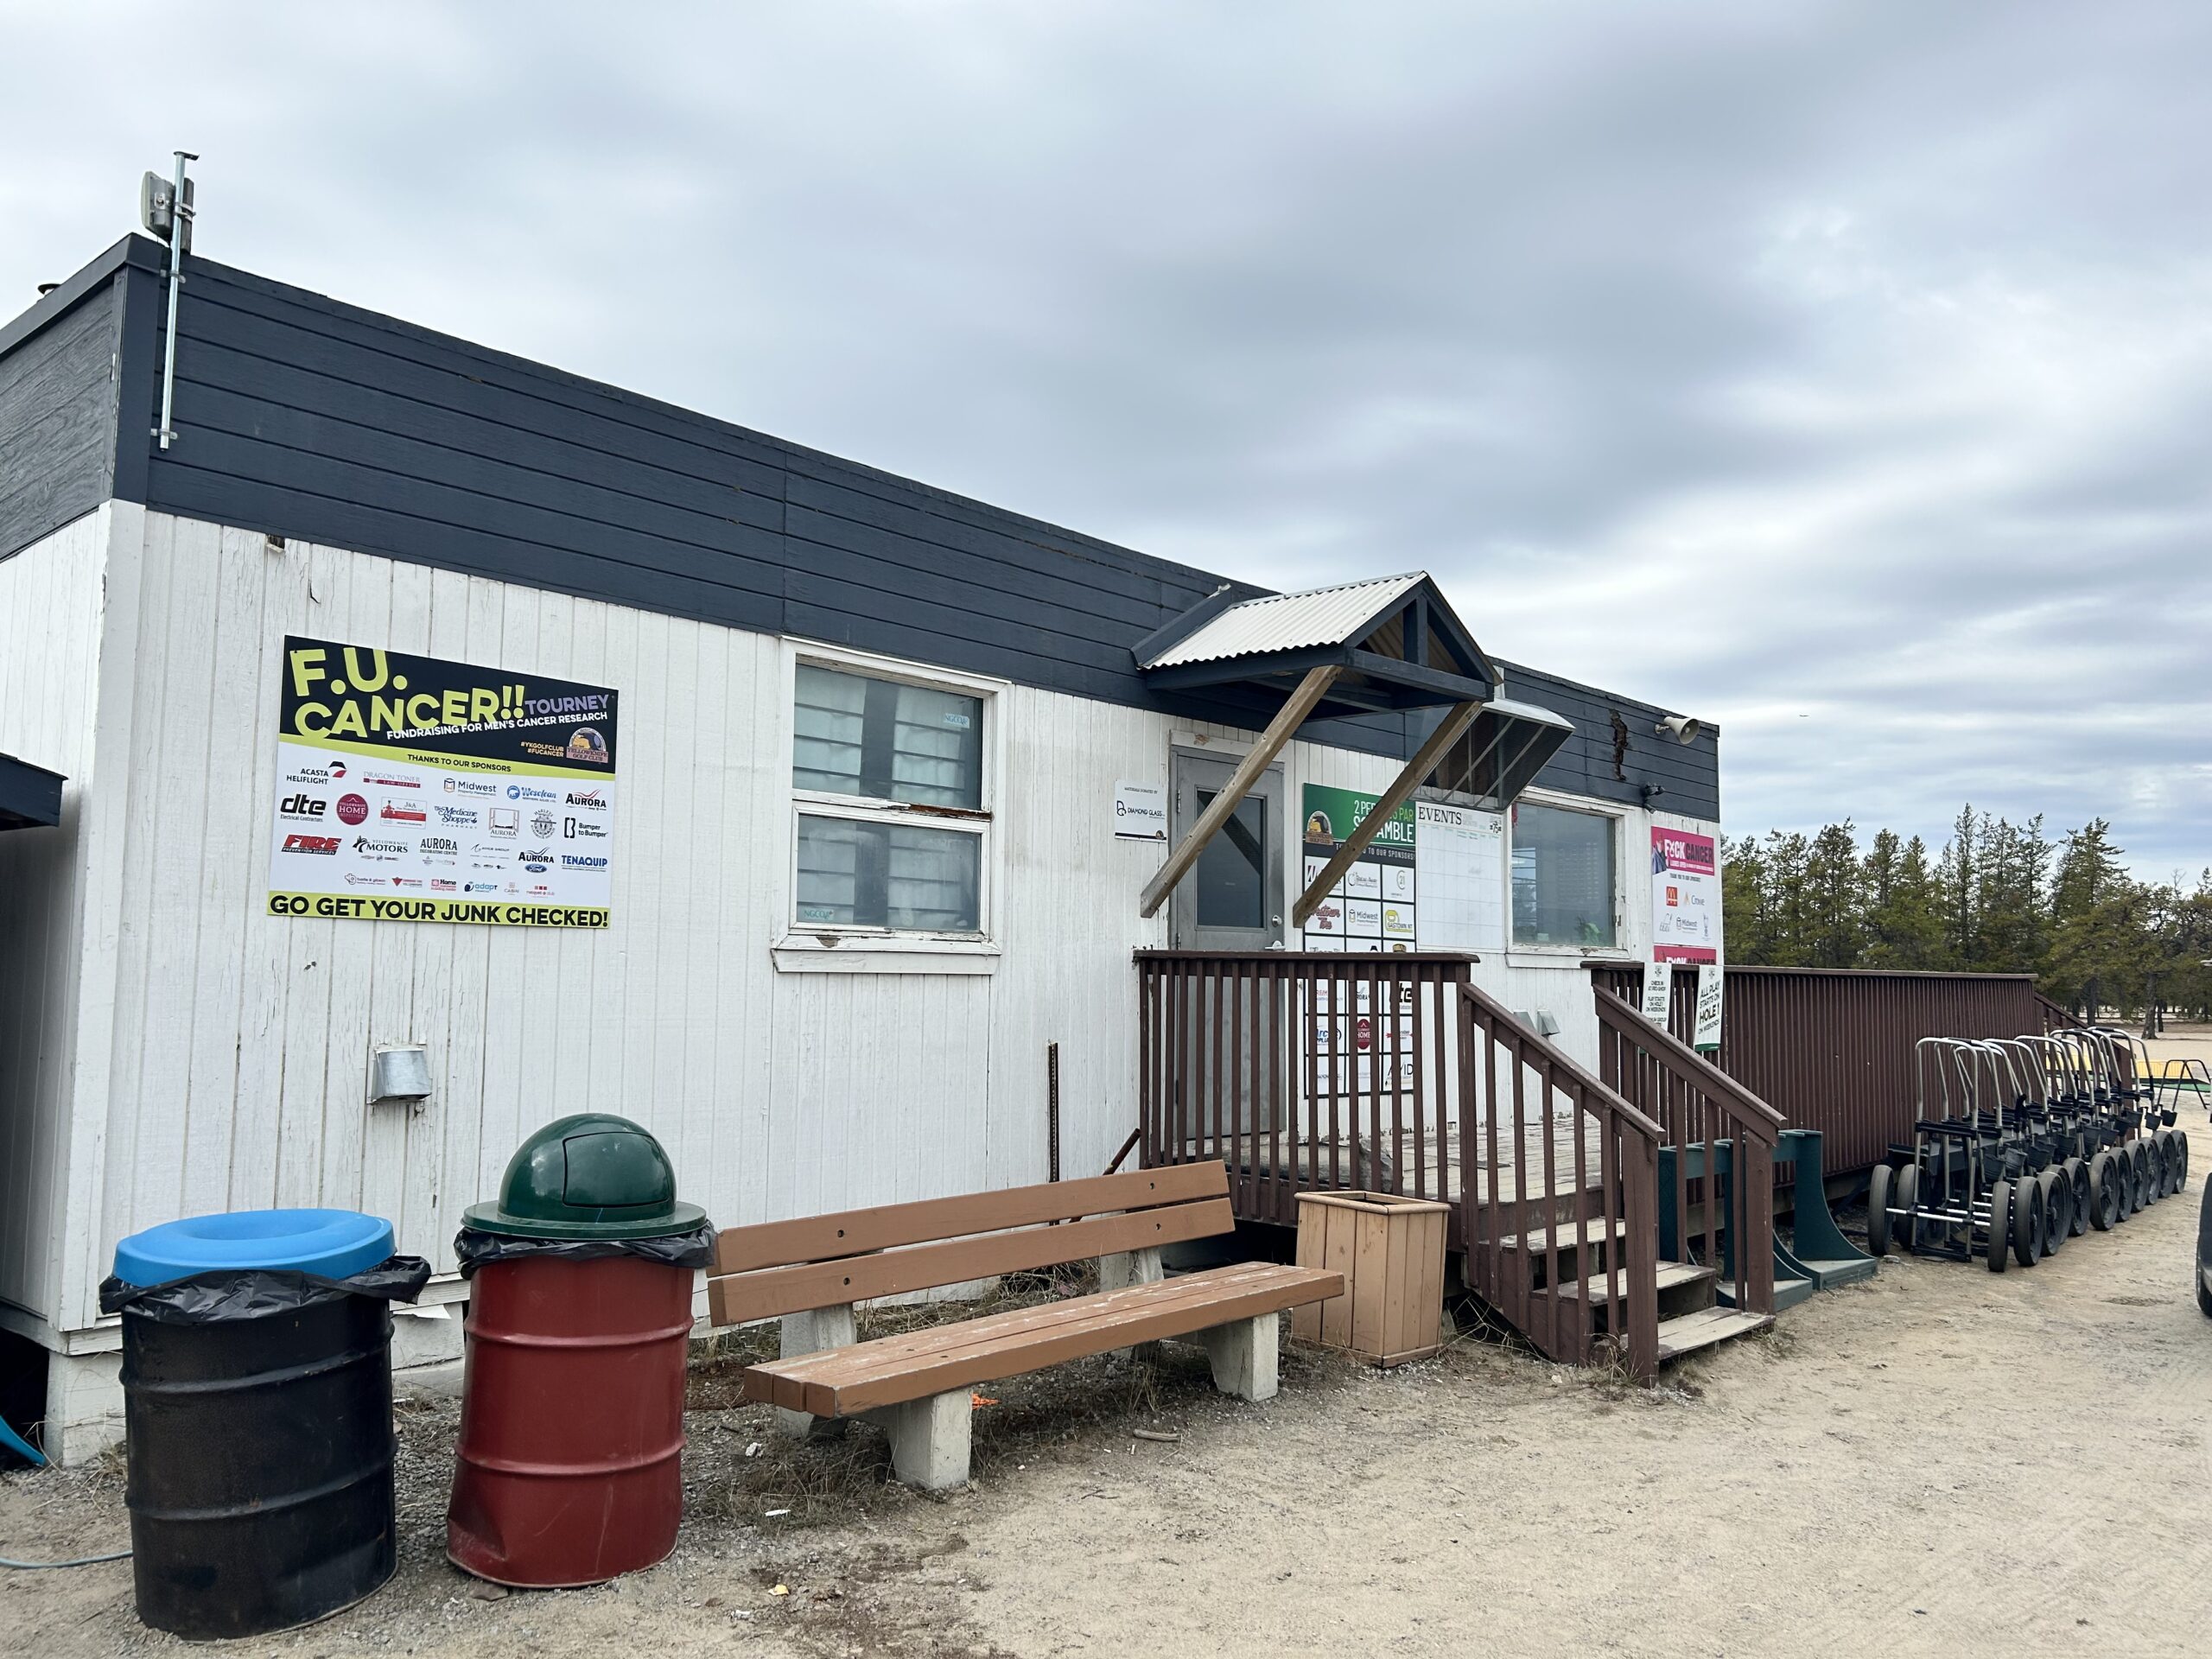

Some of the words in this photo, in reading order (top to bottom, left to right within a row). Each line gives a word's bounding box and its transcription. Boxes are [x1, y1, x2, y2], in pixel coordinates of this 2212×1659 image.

[289, 647, 408, 697] F.U.
[524, 694, 609, 715] TOURNEY
[295, 684, 525, 741] CANCER!!
[386, 725, 460, 741] FUNDRAISING
[461, 722, 482, 734] FOR
[484, 720, 516, 731] MEN'S
[517, 716, 557, 728] CANCER
[559, 711, 608, 724] RESEARCH
[527, 748, 564, 758] #FUCANCER
[408, 754, 439, 764] THANKS
[471, 762, 512, 772] SPONSORS
[286, 775, 329, 785] HELIFLIGHT
[301, 768, 329, 777] ACASTA
[364, 771, 395, 780] DRAGON
[458, 780, 498, 793] Midwest
[280, 793, 327, 816] dte
[565, 793, 607, 808] AURORA
[1354, 800, 1360, 814] 2
[339, 805, 366, 815] HOME
[1399, 807, 1414, 823] PAR
[1418, 806, 1462, 825] EVENTS
[578, 822, 601, 831] Bumper
[1353, 816, 1414, 843] SAMBLE
[584, 830, 607, 839] Bumper
[283, 834, 342, 851] FIRE
[365, 844, 409, 854] MOTORS
[420, 837, 458, 851] AURORA
[518, 852, 555, 864] AURORA
[1686, 842, 1714, 864] CANCER
[561, 855, 608, 868] TENAQUIP
[270, 894, 310, 915] GO
[316, 897, 366, 917] GET
[371, 899, 436, 920] YOUR
[441, 903, 501, 924] JUNK
[505, 906, 609, 928] CHECKED!
[1357, 911, 1379, 920] Midwest
[1700, 987, 1709, 999] ALL
[1709, 980, 1720, 993] PLAY
[1699, 1003, 1717, 1025] HOLE
